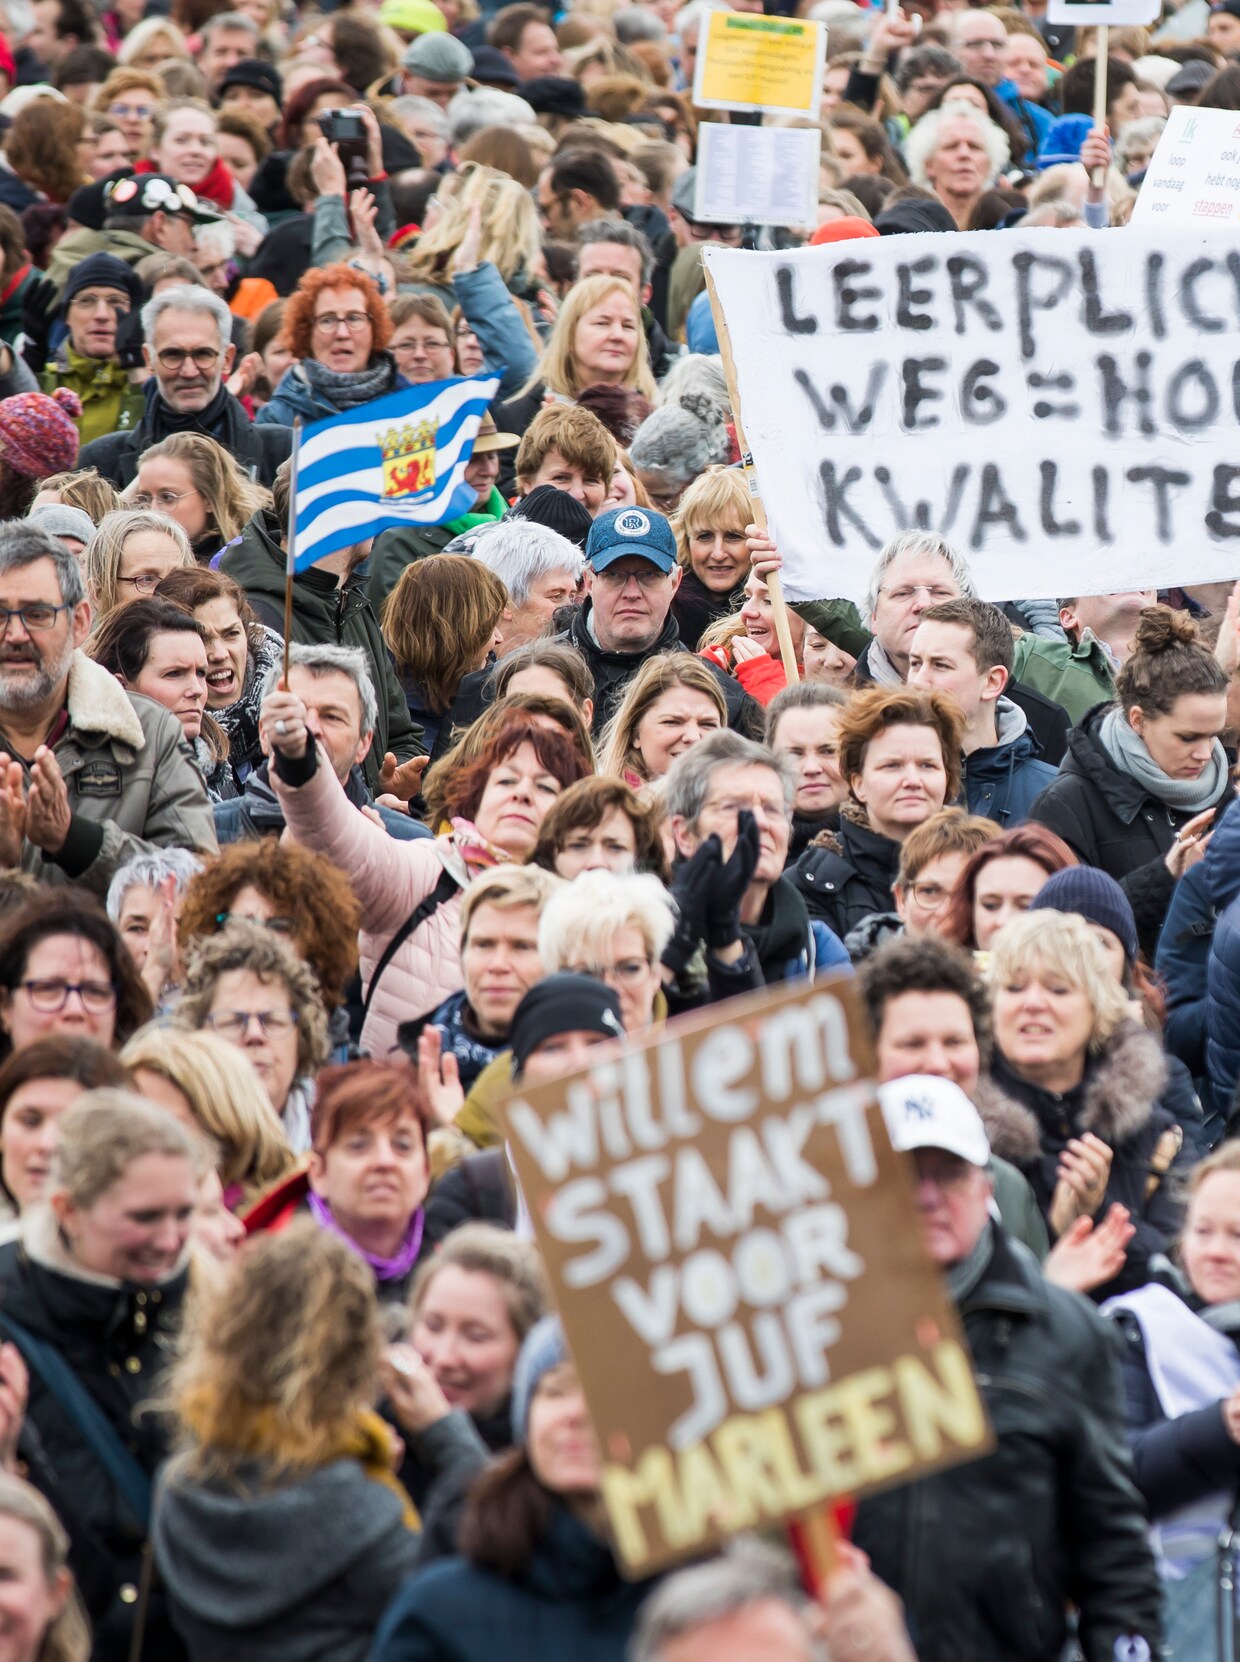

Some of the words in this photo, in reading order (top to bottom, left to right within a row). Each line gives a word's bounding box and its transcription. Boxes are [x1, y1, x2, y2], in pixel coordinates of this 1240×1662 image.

[1182, 117, 1198, 140] Ik
[1168, 153, 1186, 167] loop
[1220, 149, 1238, 161] ook
[1153, 178, 1186, 192] vandaag
[1204, 172, 1225, 186] hebt
[1151, 201, 1170, 213] voor
[1192, 198, 1234, 216] stappen
[546, 1082, 880, 1290] STAAKT
[612, 1202, 866, 1349] VOOR
[651, 1282, 849, 1453] JUF
[604, 1338, 989, 1571] MARLEEN
